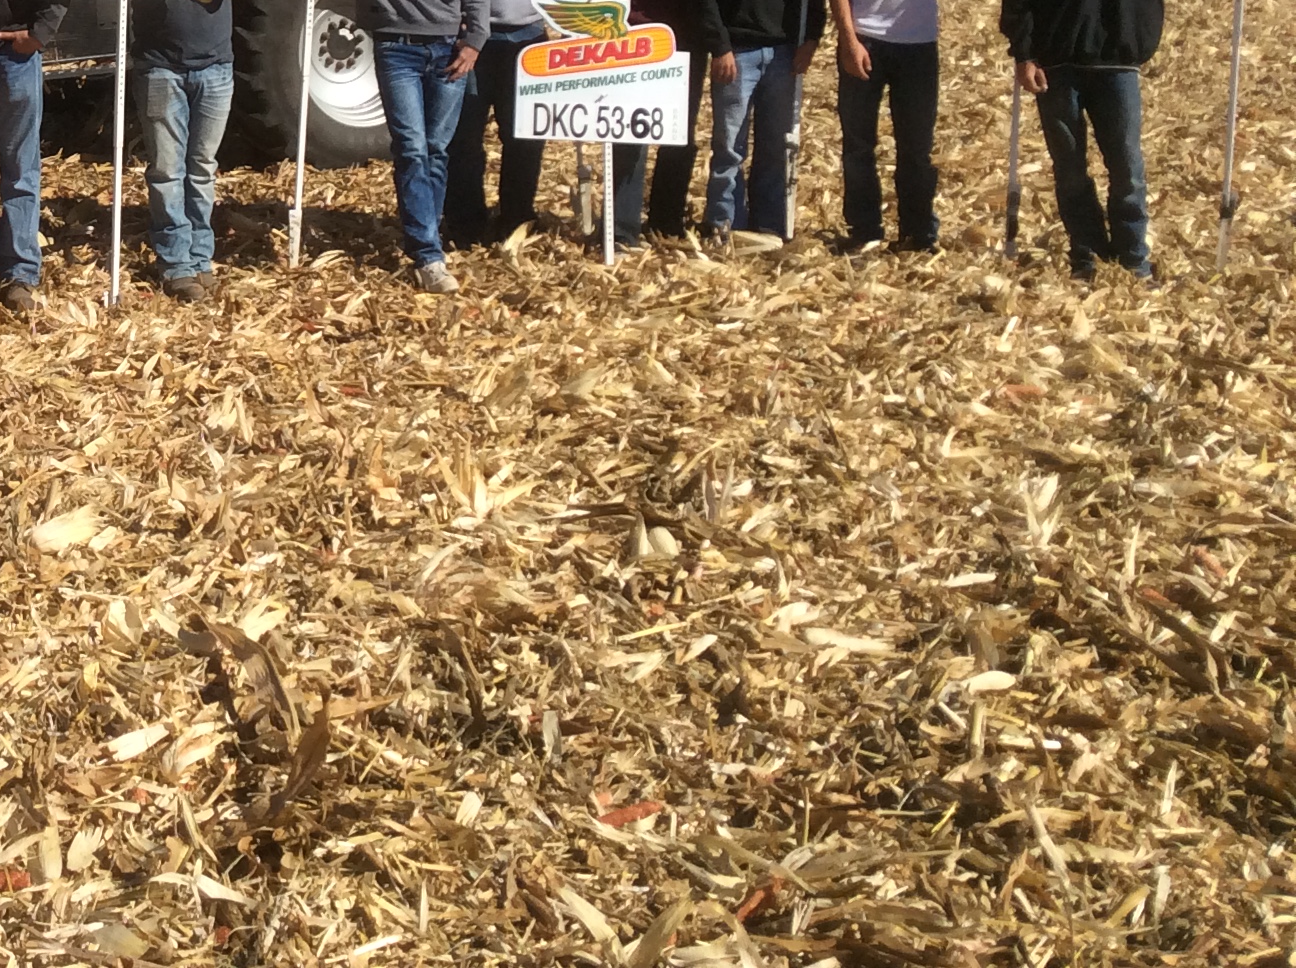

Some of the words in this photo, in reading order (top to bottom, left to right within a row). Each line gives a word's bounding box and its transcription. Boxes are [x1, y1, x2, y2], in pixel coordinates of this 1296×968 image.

[548, 36, 653, 70] DEKALB
[519, 81, 553, 97] WHEN
[554, 71, 637, 93] PERFORMANCE
[640, 65, 683, 82] COUNTS
[532, 102, 589, 139] DKC
